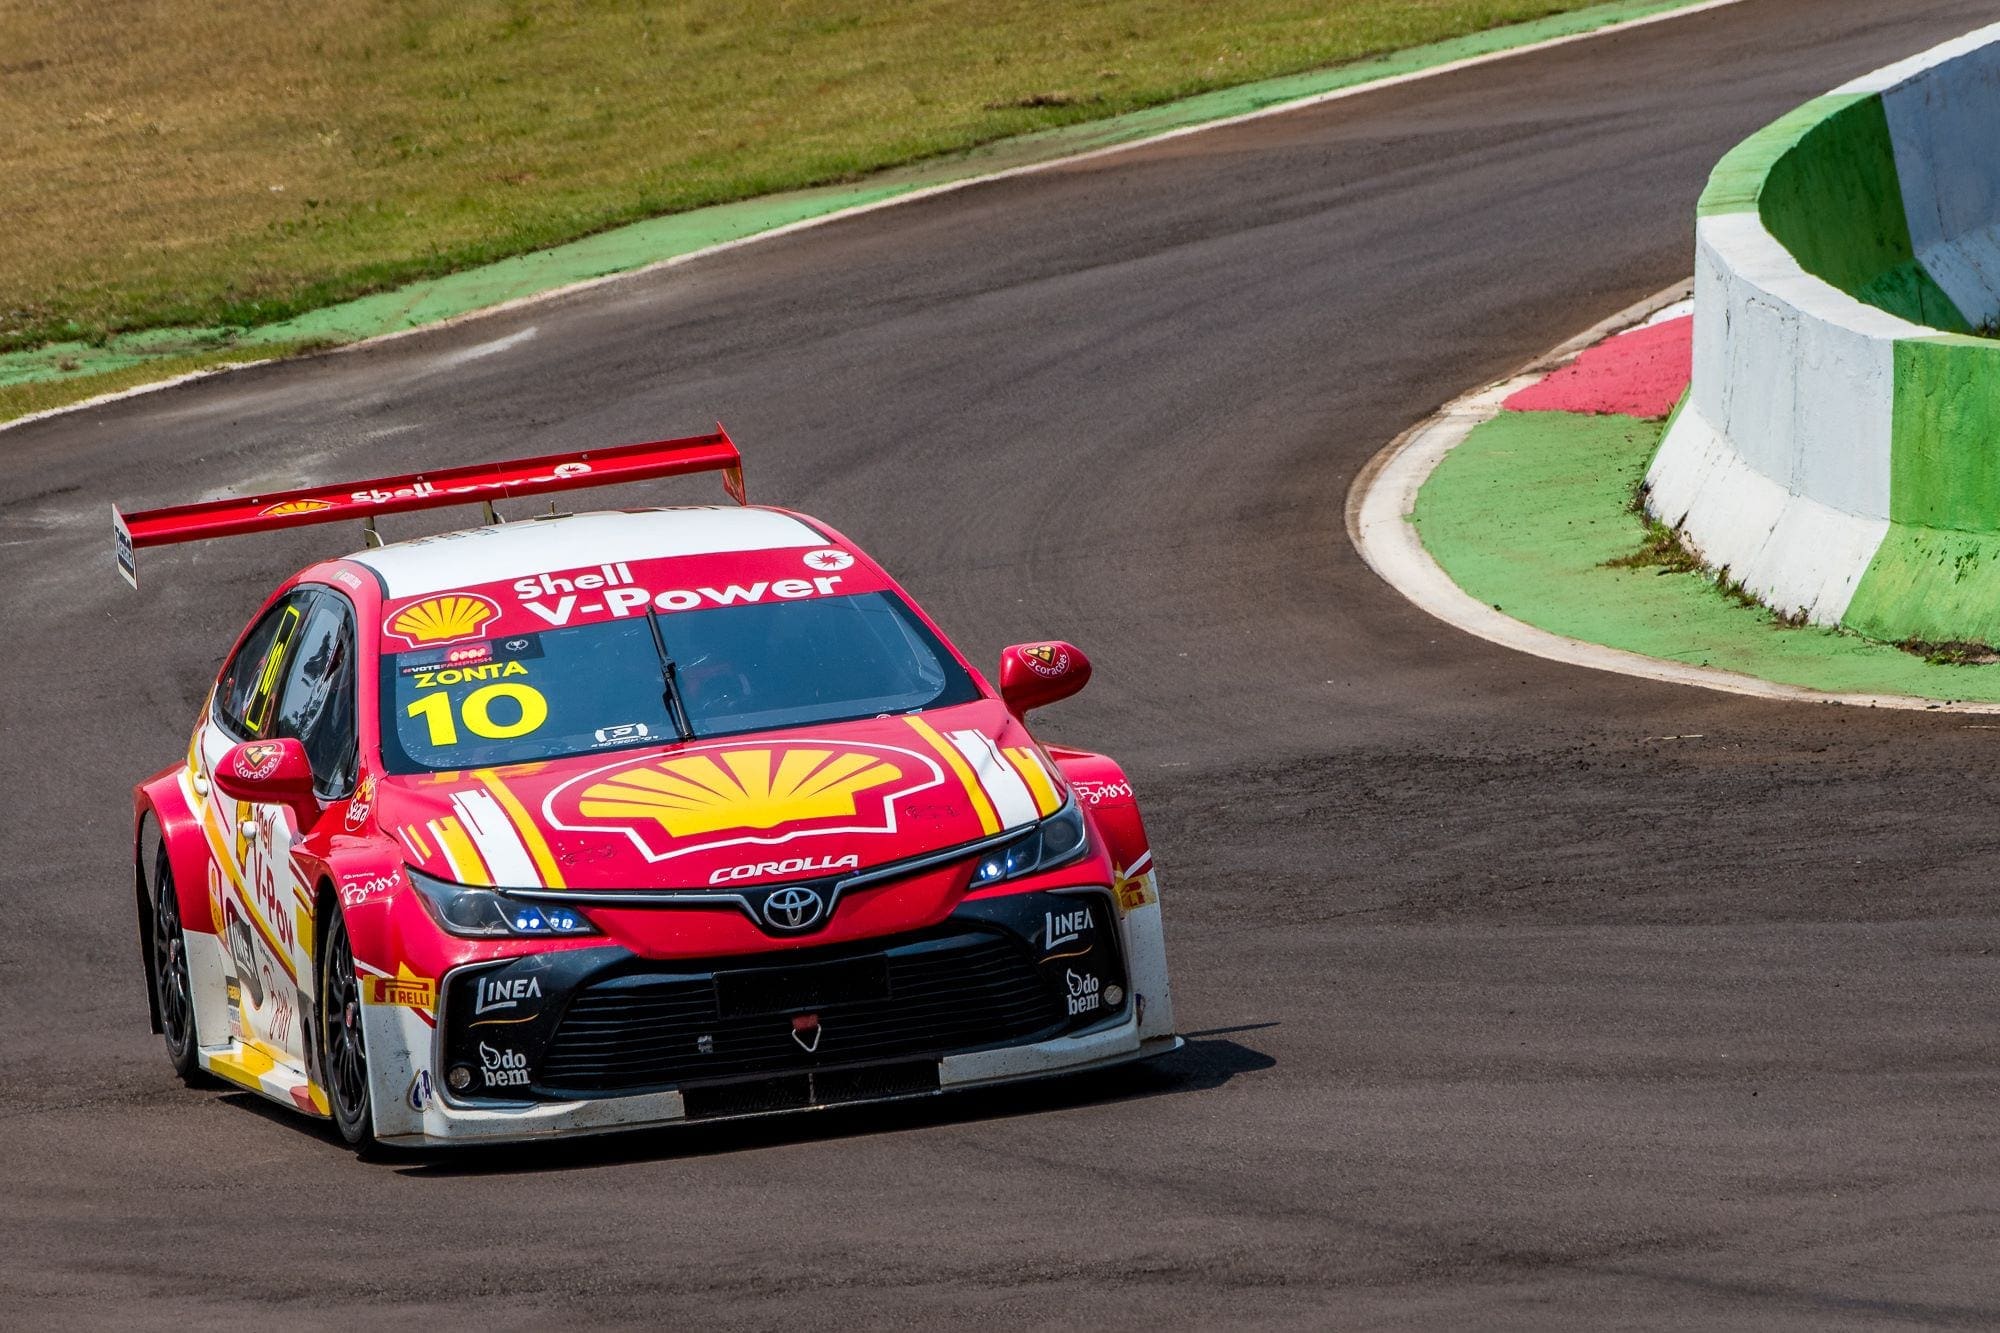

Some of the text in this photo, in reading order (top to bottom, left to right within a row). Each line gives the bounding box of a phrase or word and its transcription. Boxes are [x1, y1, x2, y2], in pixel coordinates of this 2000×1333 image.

[512, 561, 635, 600] Shell
[521, 574, 844, 626] V-Power
[413, 660, 529, 689] ZONTA
[407, 682, 549, 747] 10
[708, 854, 860, 885] COROLLA
[253, 842, 295, 956] V-Pow
[1045, 907, 1095, 951] LINEA
[374, 979, 430, 1007] PIRELLI
[475, 976, 543, 1016] LINEA
[1081, 973, 1099, 994] do
[1067, 991, 1100, 1016] bem
[502, 1048, 528, 1071] do
[480, 1065, 531, 1087] bem
